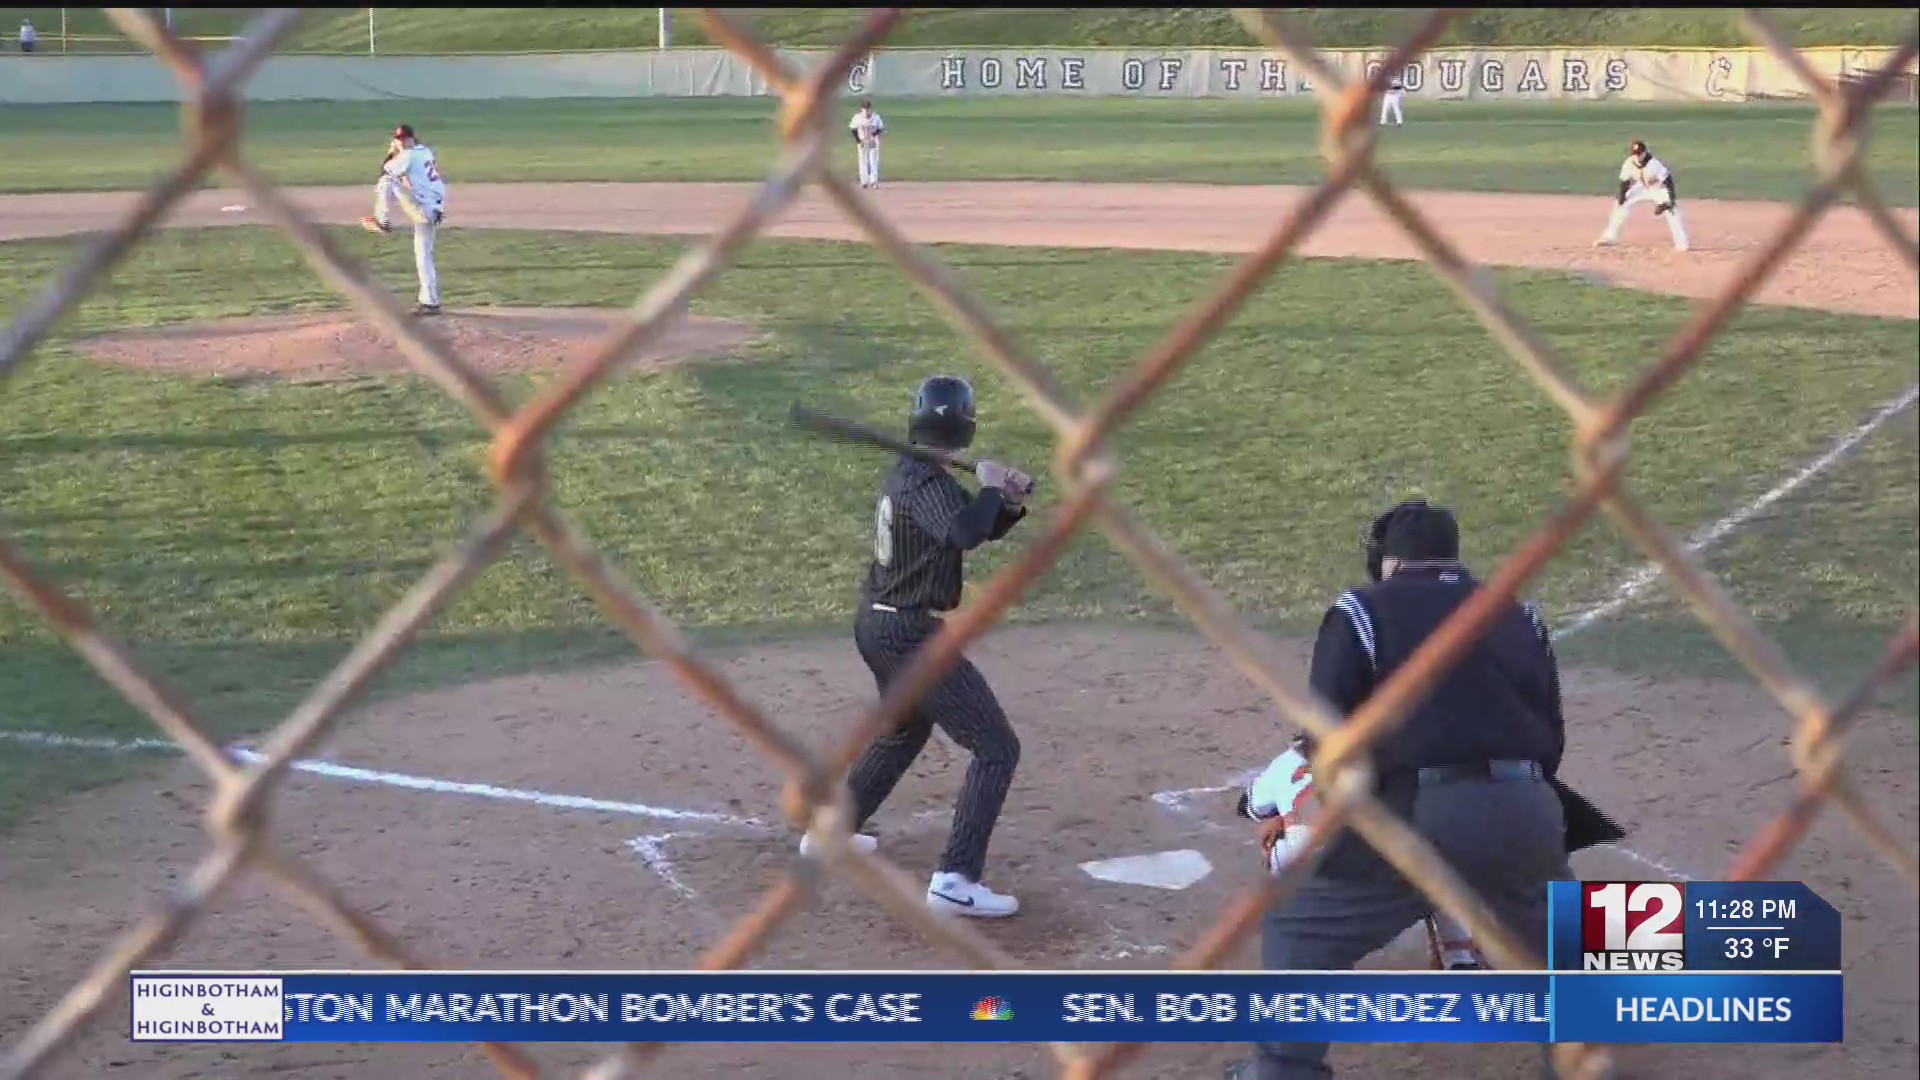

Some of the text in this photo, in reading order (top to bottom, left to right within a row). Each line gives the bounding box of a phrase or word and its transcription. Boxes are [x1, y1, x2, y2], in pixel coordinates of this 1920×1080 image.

[942, 57, 1085, 89] HOME
[1123, 58, 1182, 90] OF
[1220, 59, 1314, 91] TH
